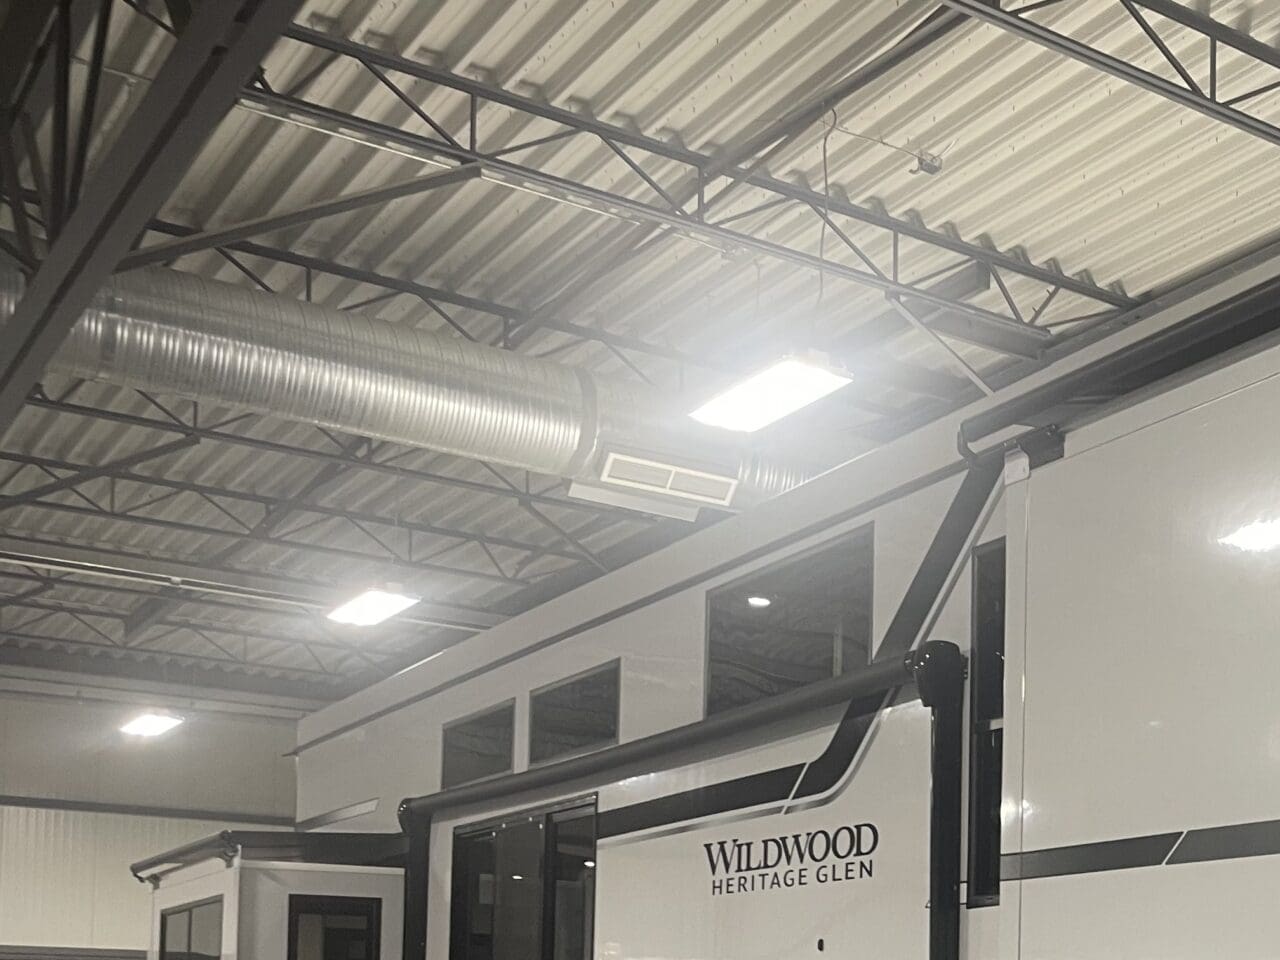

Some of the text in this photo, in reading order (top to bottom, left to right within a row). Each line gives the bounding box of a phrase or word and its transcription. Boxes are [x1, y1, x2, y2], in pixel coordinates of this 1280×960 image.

[703, 823, 879, 876] WILDWOOD
[712, 859, 873, 895] HERITAGE GLEN
